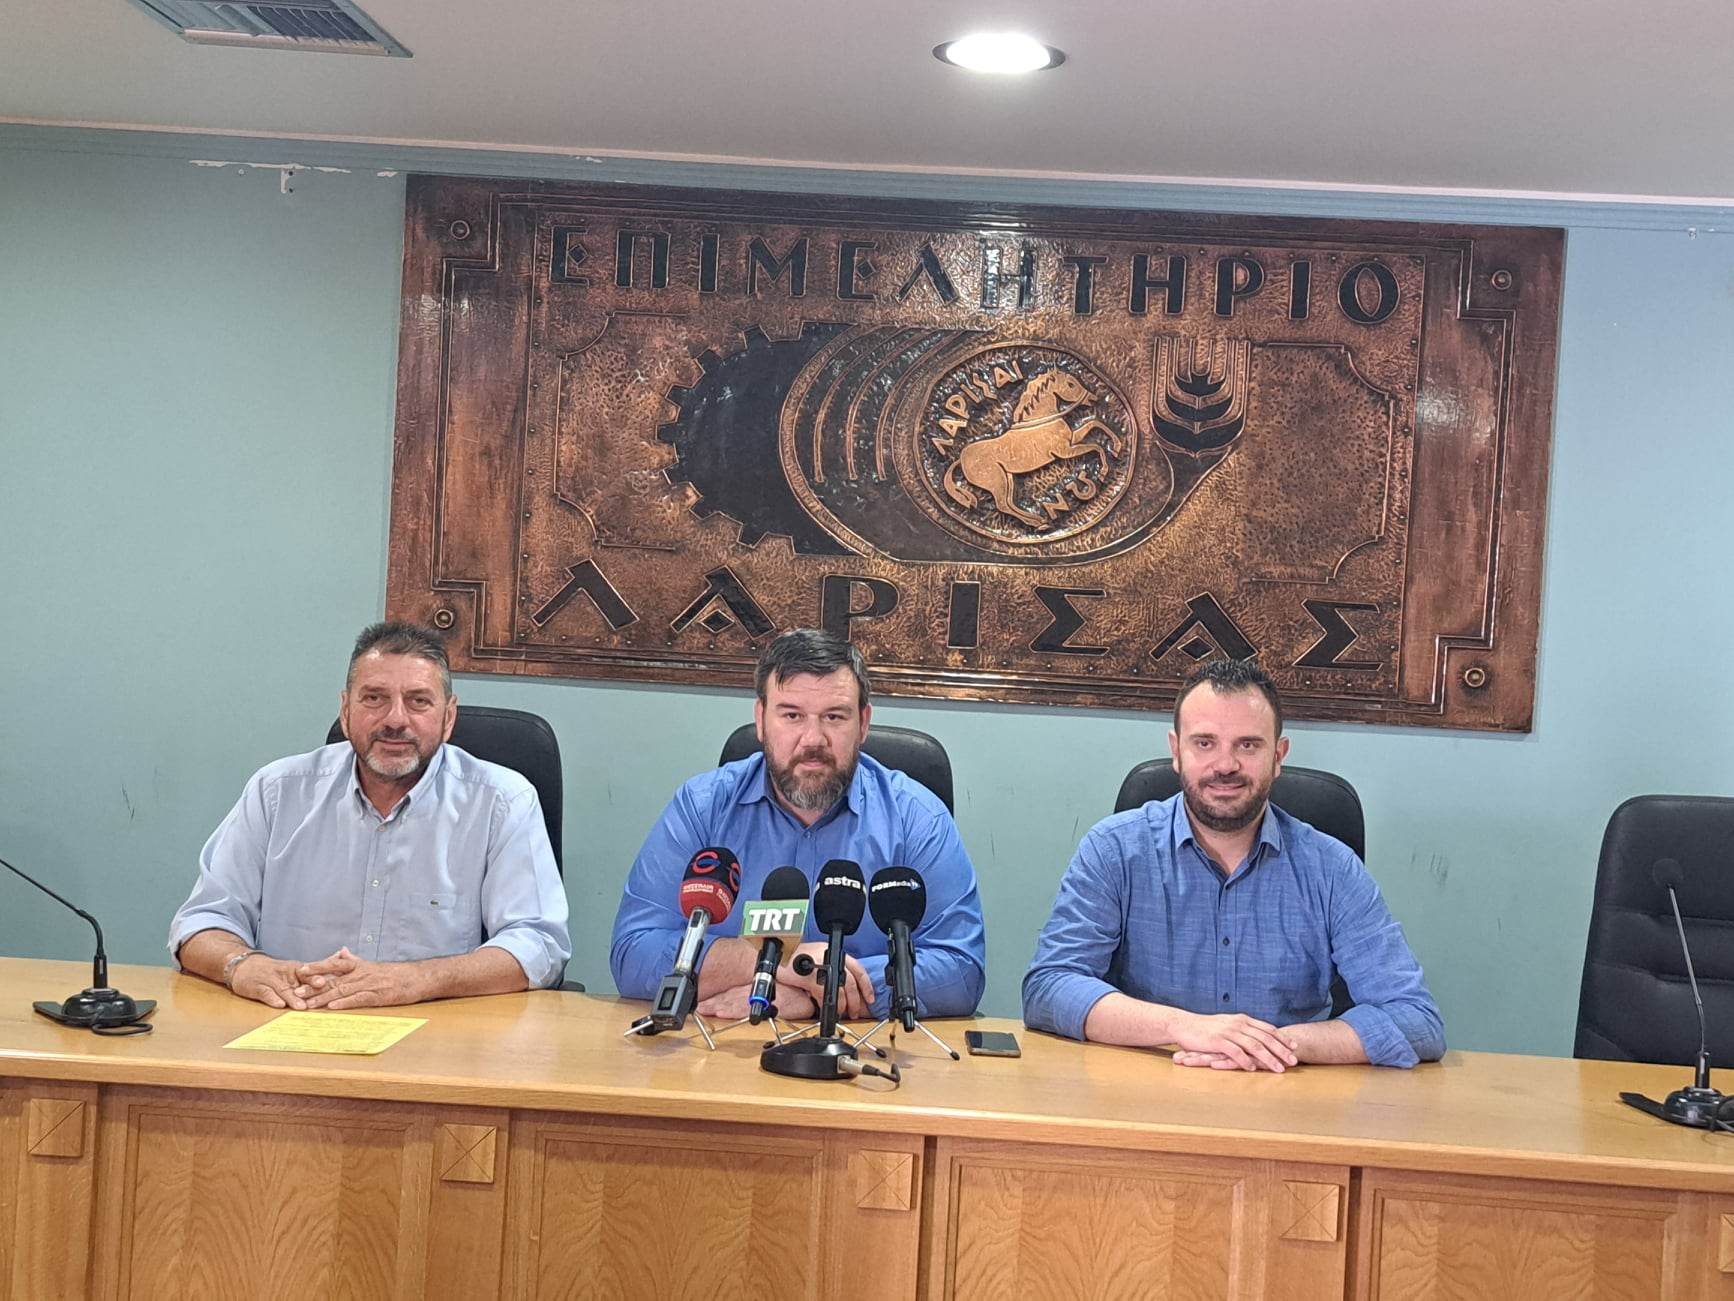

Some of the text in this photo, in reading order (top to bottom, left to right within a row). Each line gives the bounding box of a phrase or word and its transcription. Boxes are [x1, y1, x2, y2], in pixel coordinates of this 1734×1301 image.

[549, 224, 1401, 325] ΕΠΙΜΕΛΗΤΗΡΙΟ
[531, 557, 1383, 672] ΛΑΡΙΣΑΣ
[824, 876, 861, 890] astra
[748, 908, 801, 931] TRT
